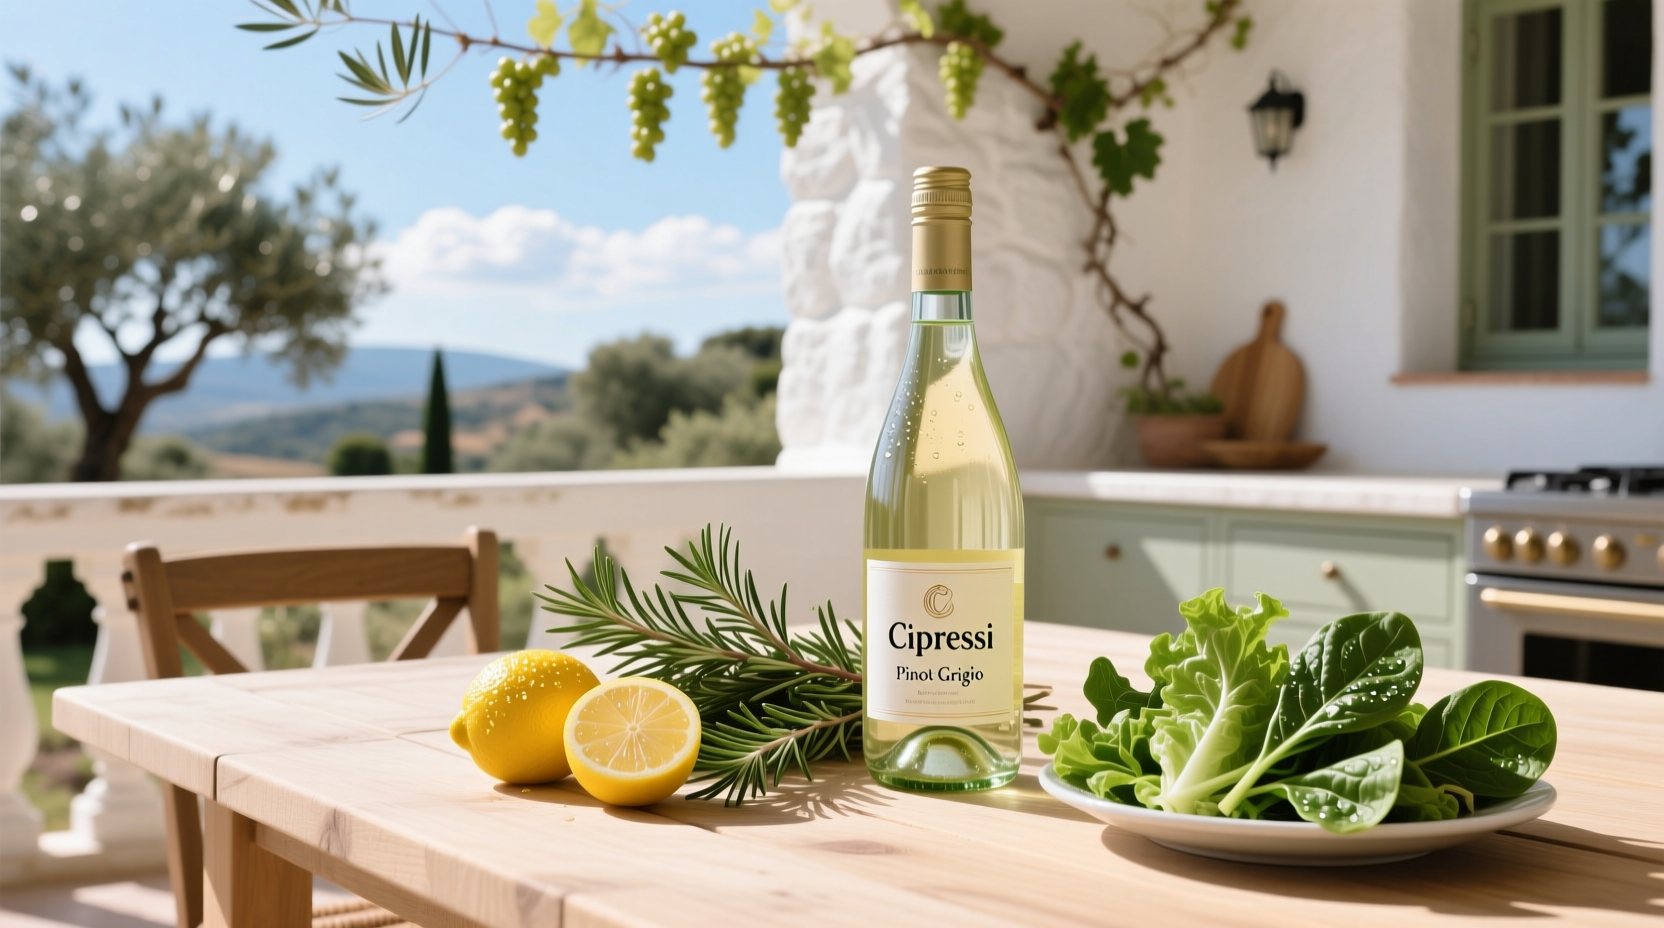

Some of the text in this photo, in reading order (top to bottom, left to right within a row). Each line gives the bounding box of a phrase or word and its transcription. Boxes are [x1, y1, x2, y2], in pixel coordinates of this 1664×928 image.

[888, 621, 994, 657] Cipressi
[896, 665, 984, 688] Pinot Grigio
